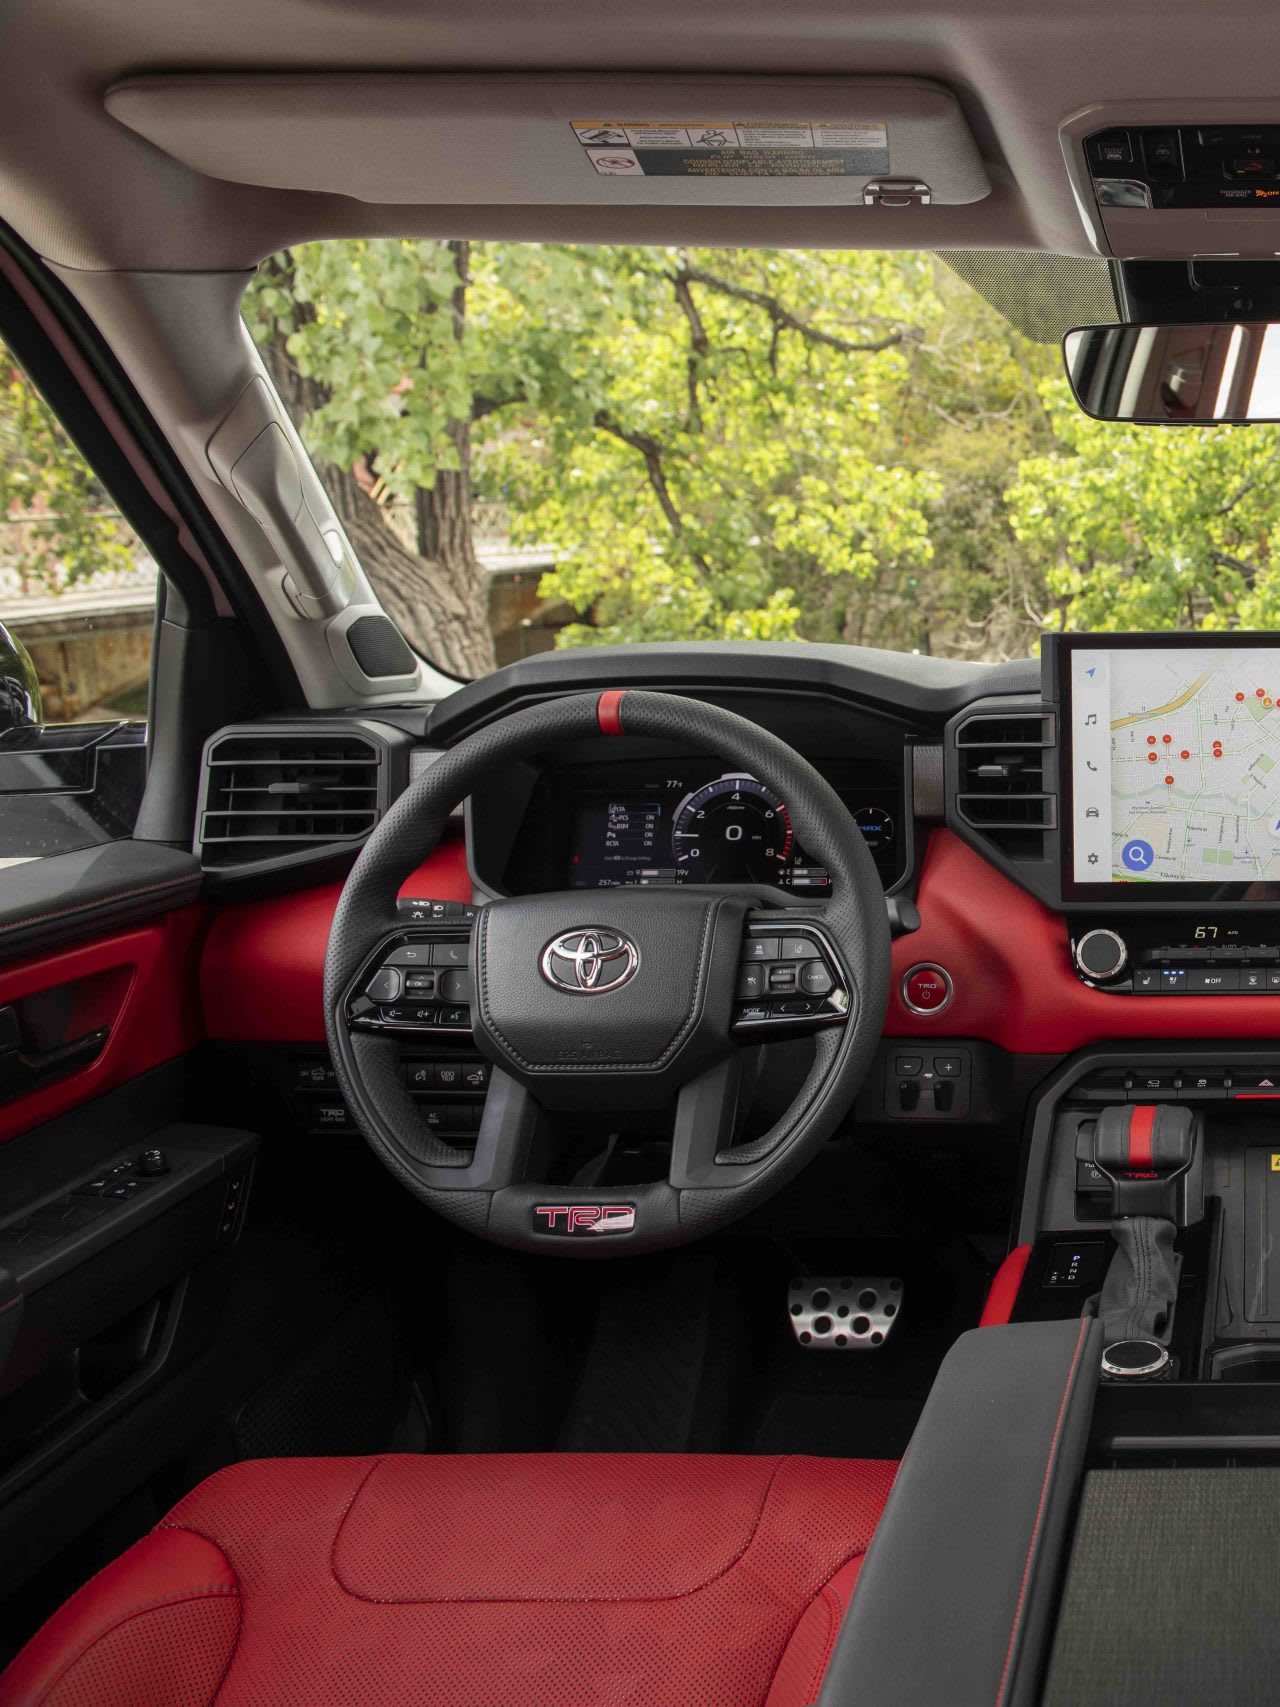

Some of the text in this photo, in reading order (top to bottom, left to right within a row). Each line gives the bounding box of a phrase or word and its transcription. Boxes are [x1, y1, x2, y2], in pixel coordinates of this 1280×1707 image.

[731, 792, 741, 801] 4
[696, 810, 705, 819] 2
[764, 810, 774, 818] 6
[725, 825, 743, 841] 0
[690, 848, 700, 857] 0
[765, 848, 775, 856] 8
[1194, 926, 1218, 939] 67
[320, 1108, 345, 1117] TRD
[536, 1206, 635, 1233] TRD
